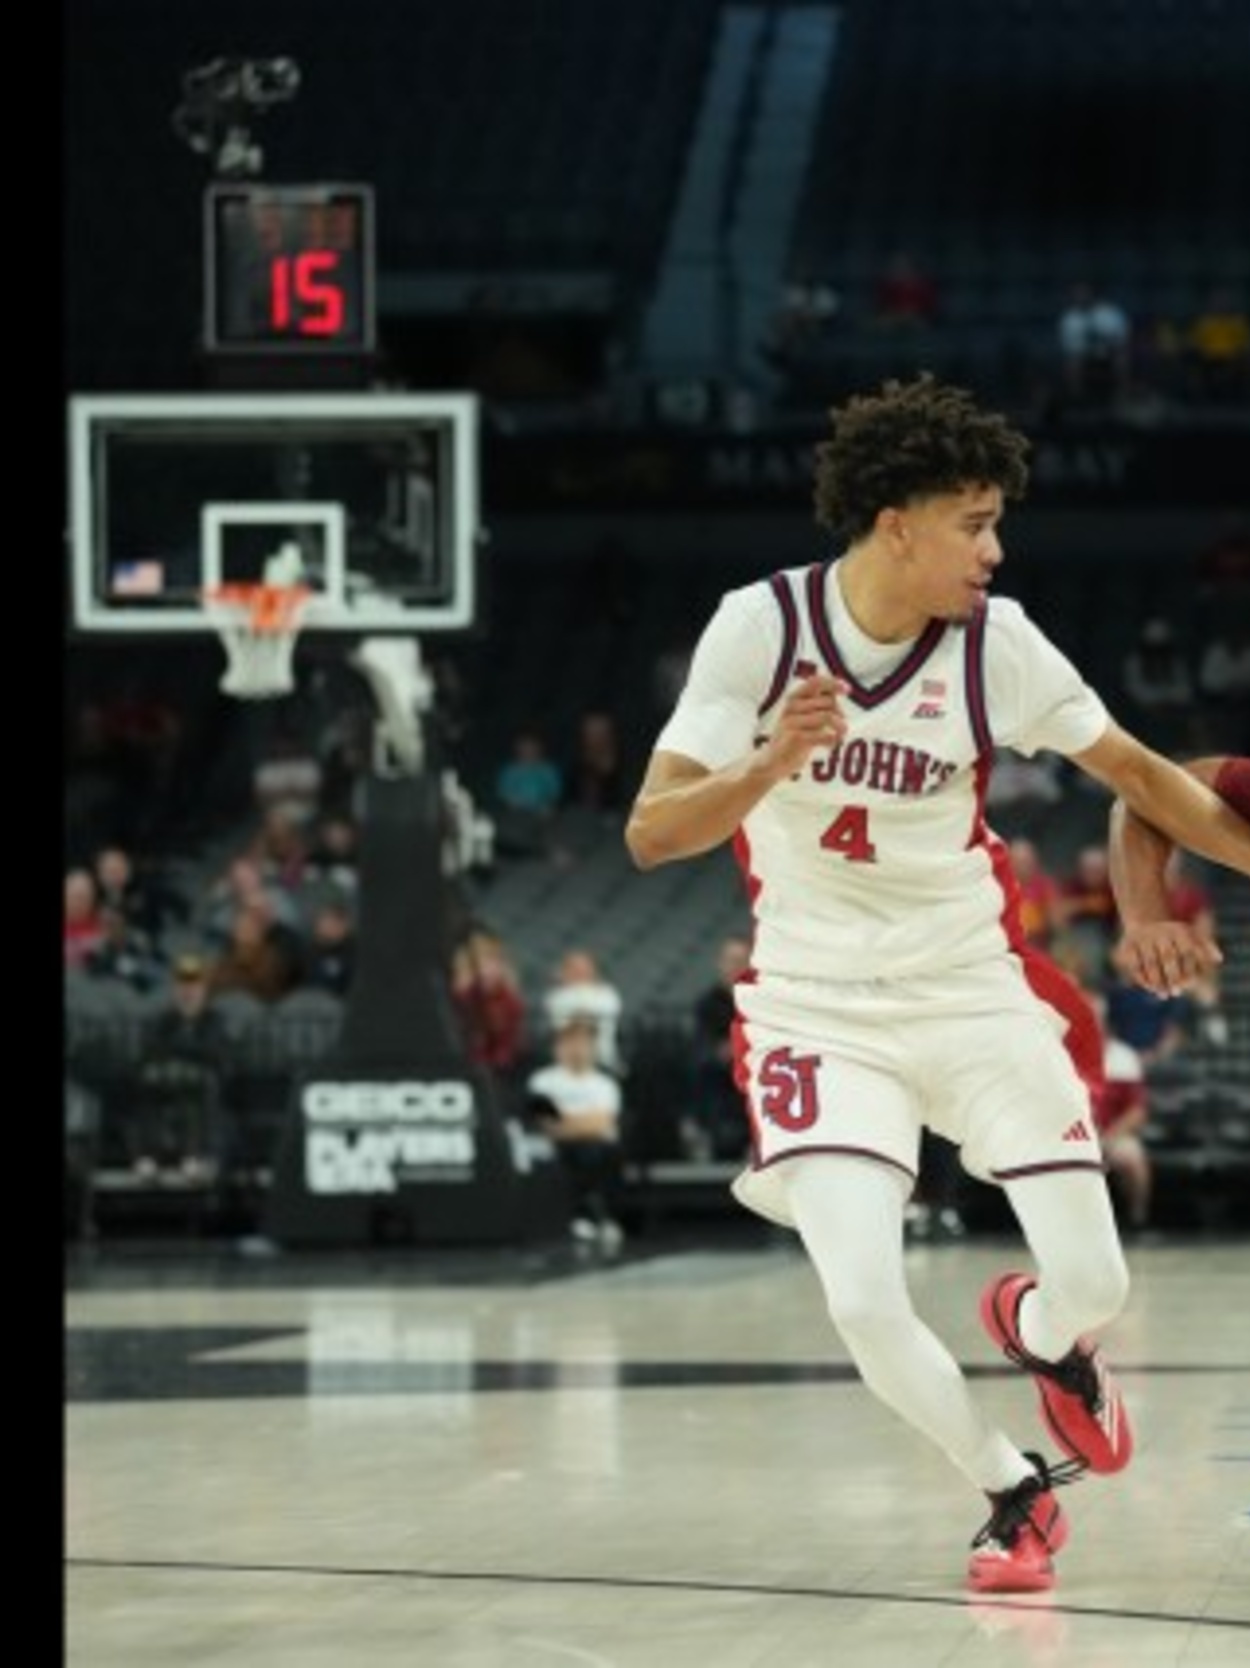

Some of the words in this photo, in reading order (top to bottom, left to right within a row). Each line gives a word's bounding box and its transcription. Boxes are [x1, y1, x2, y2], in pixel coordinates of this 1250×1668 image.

[271, 250, 344, 334] 15
[820, 804, 877, 863] 4
[302, 1080, 475, 1122] GEICO
